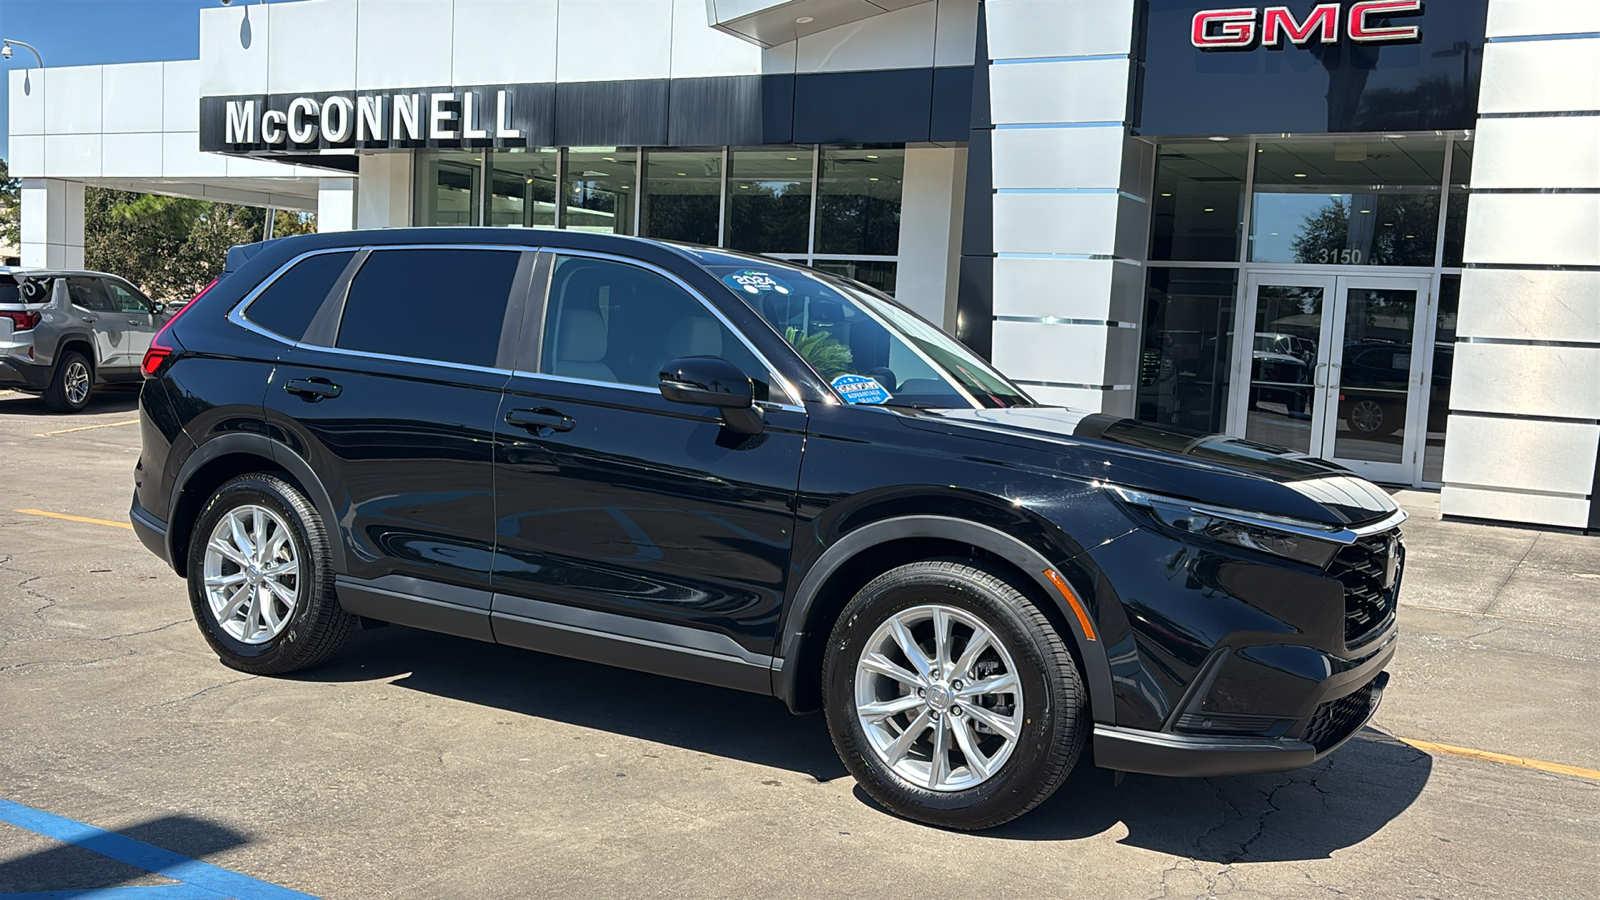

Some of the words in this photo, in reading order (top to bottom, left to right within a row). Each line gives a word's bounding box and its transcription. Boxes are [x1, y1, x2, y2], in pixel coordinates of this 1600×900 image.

[1191, 0, 1421, 48] GMC
[225, 90, 523, 145] McCONNELL
[1318, 247, 1362, 264] 3150
[732, 275, 777, 286] 2024
